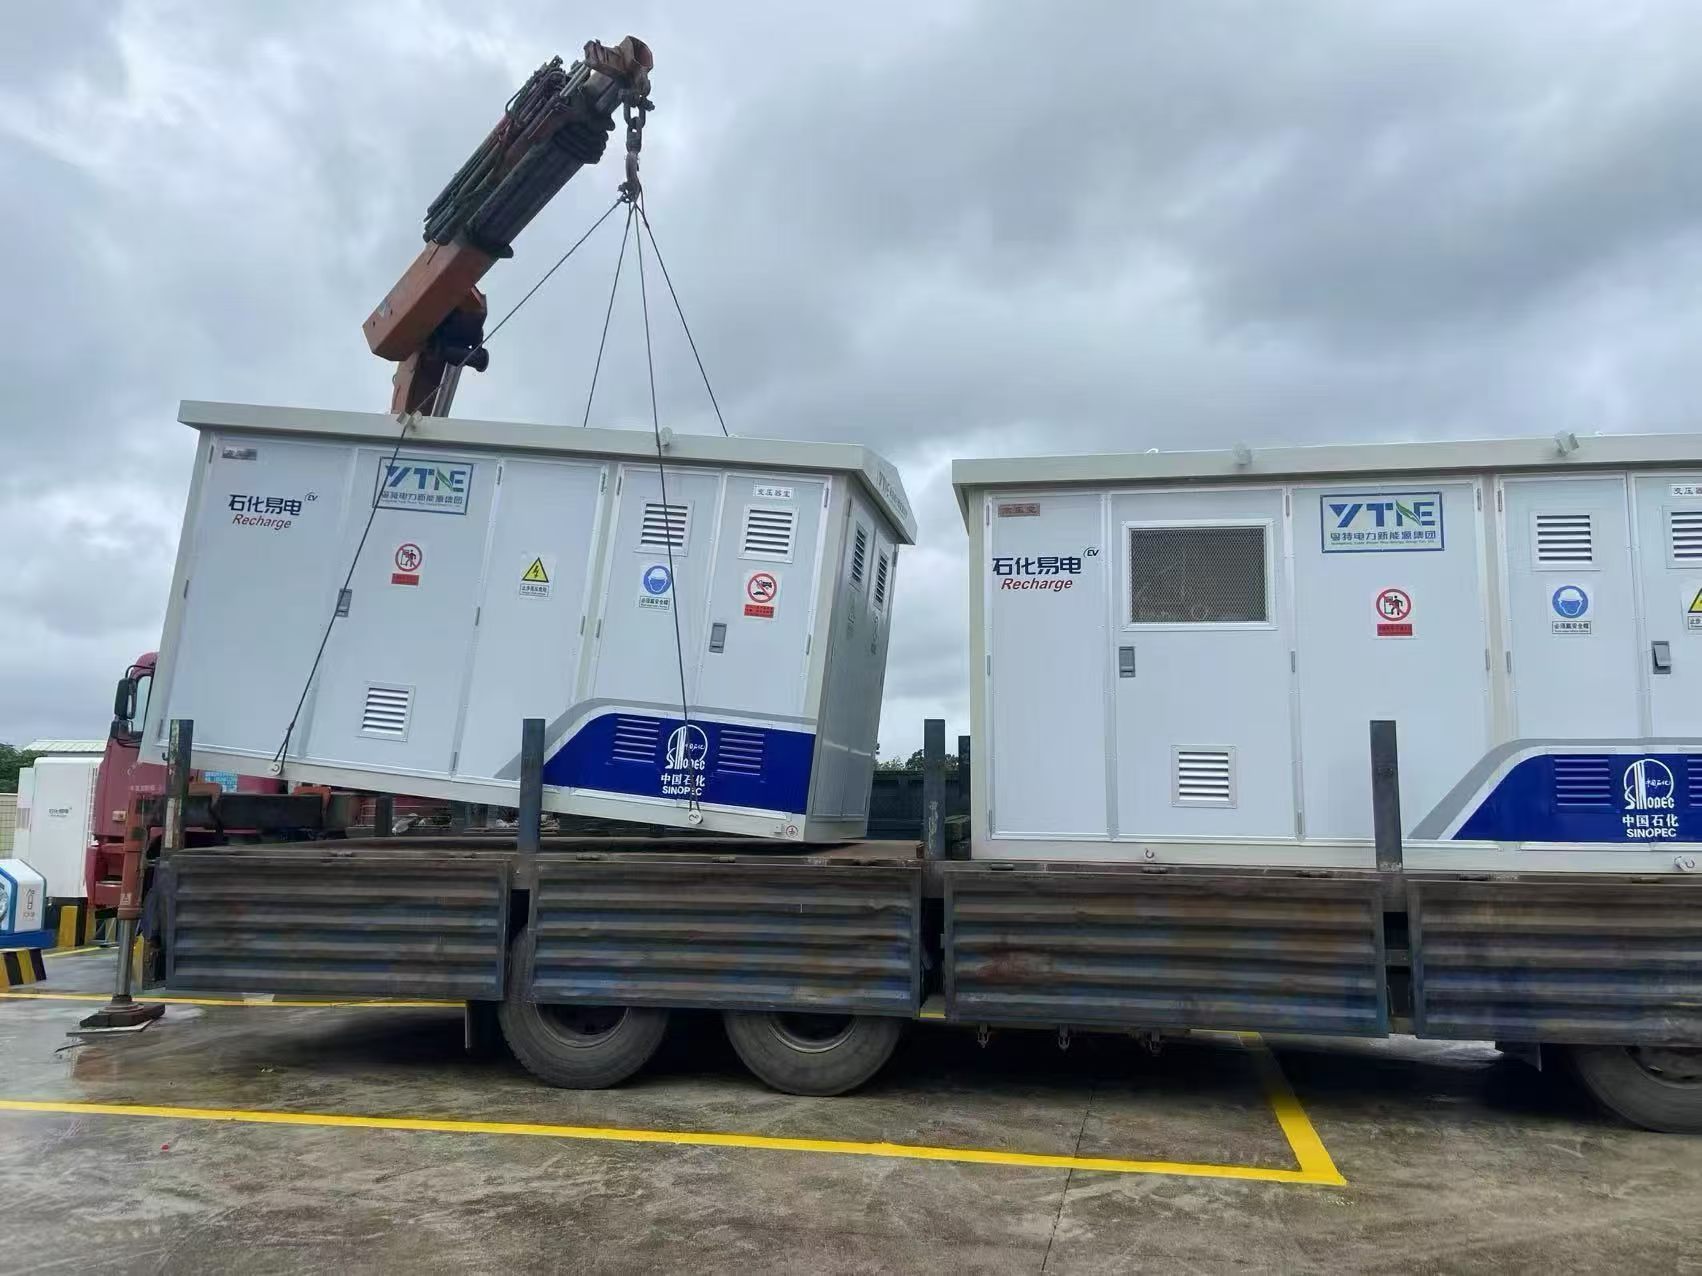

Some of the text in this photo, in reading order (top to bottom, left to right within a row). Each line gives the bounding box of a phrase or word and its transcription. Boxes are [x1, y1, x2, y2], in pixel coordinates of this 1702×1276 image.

[385, 465, 466, 493] YTNE
[228, 494, 302, 516] 石化易电
[232, 513, 292, 531] Recharge
[1329, 500, 1435, 528] YTNE
[1330, 531, 1436, 541] 粤特电力新能源集团
[992, 556, 1082, 576] 石化易电
[1001, 578, 1073, 592] Recharge
[661, 772, 706, 787] 中国石化
[1622, 813, 1680, 828] 中国石化
[1626, 827, 1677, 838] SINOPEC
